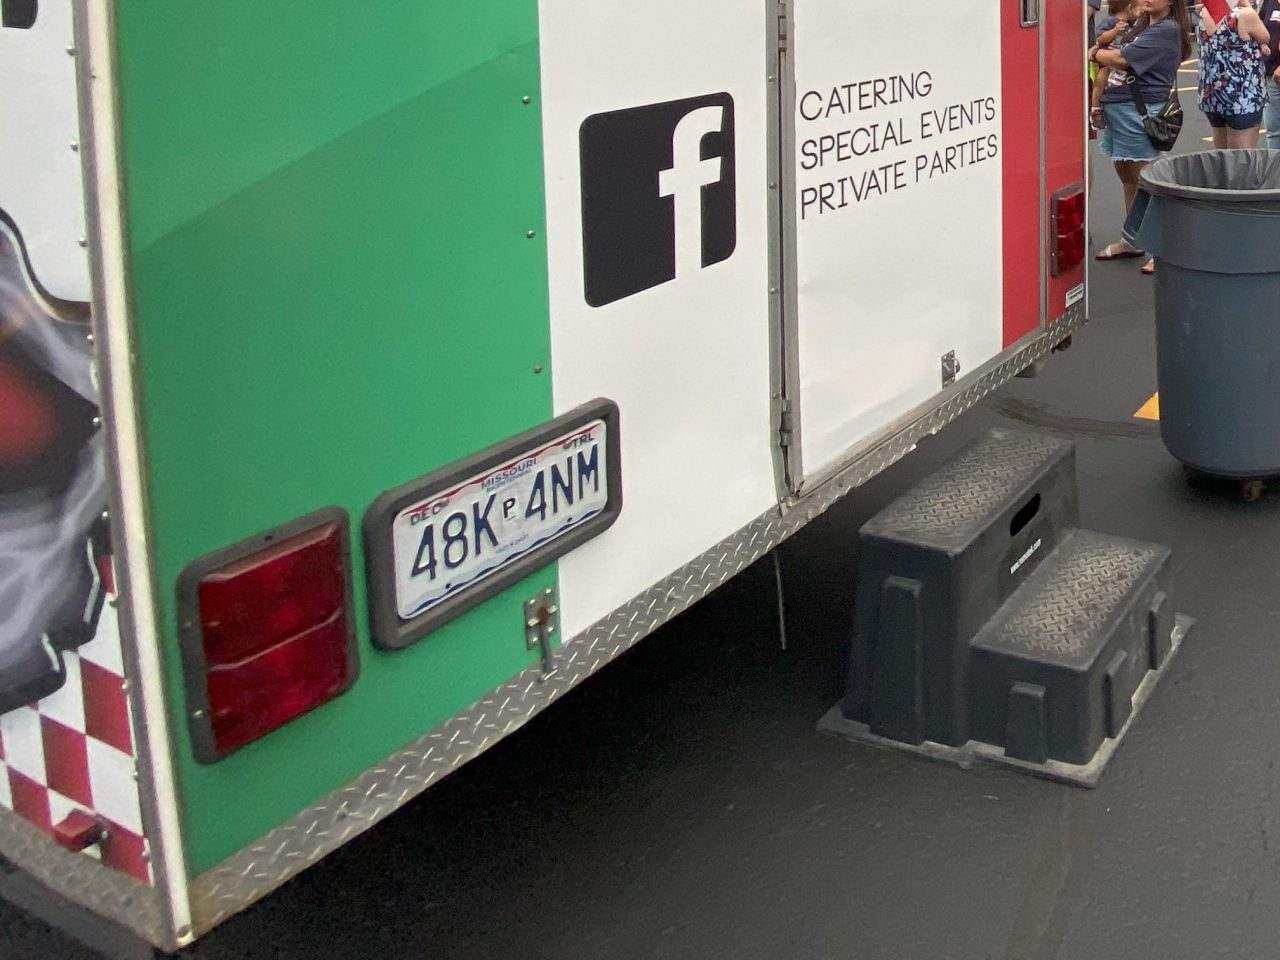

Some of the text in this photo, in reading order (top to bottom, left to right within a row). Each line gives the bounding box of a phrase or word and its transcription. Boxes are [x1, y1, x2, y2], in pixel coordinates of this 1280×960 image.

[799, 70, 933, 122] CATERING
[799, 97, 996, 171] SPECIAL EVENTS
[800, 134, 999, 220] PRIVATE PARTIES
[481, 458, 538, 490] MISSOURI
